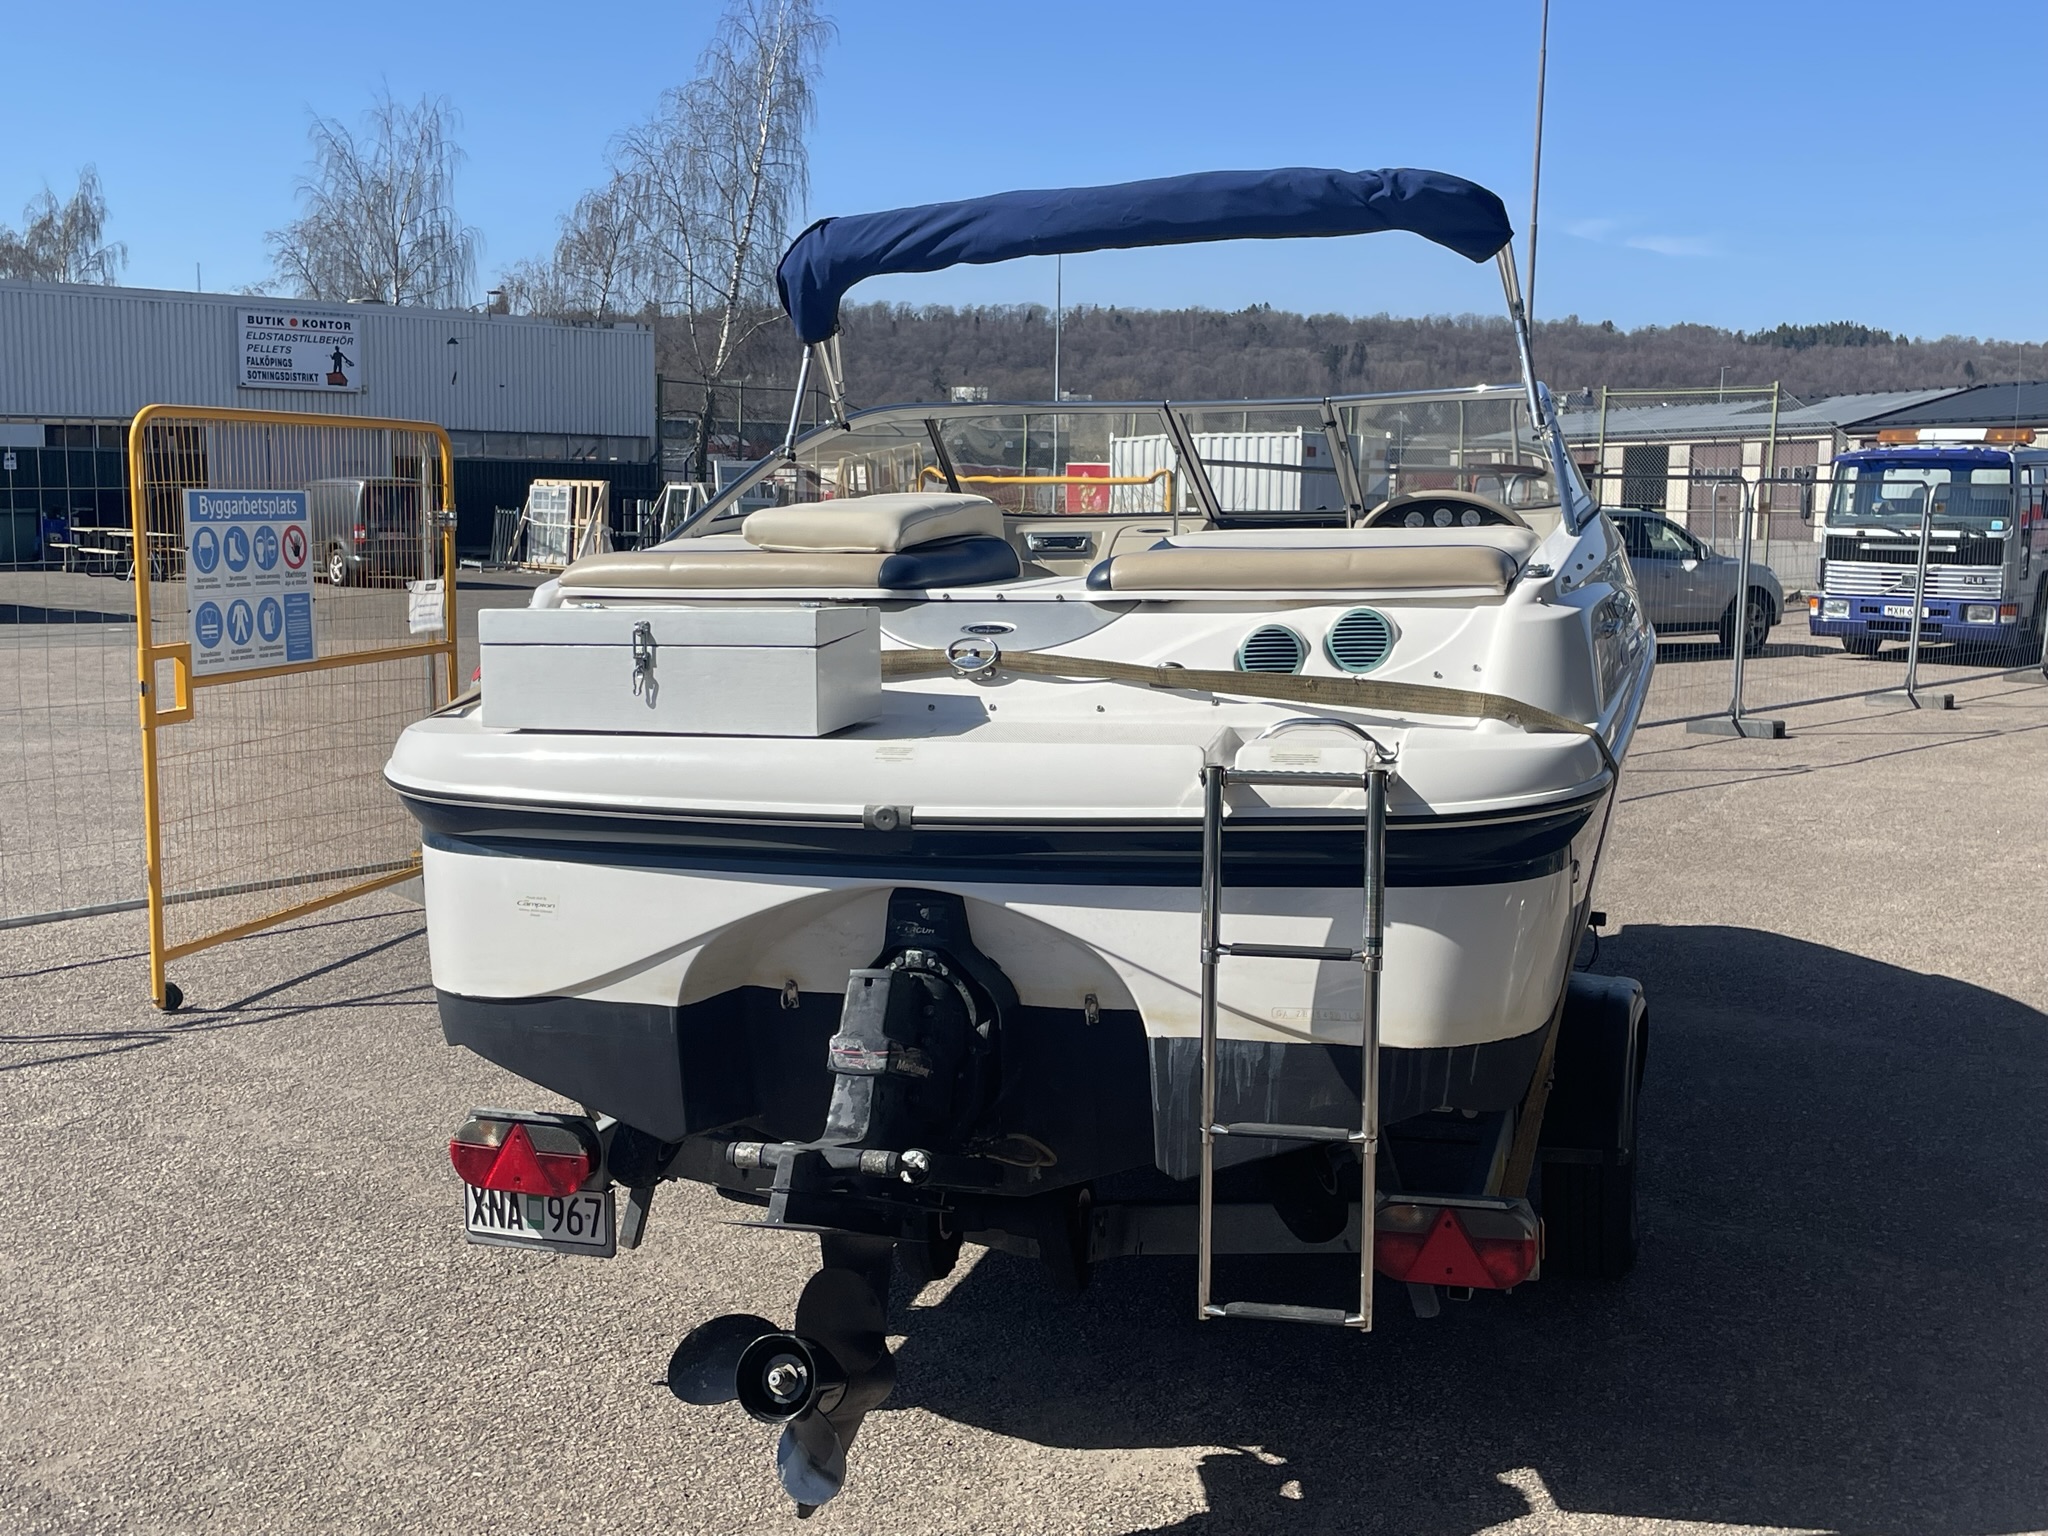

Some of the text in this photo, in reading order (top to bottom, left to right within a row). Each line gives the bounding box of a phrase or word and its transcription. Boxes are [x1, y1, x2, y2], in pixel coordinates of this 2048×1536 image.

[247, 315, 352, 331] BUTIK KONTOR
[246, 331, 354, 346] ELDSTADSTILLBEHÖR
[246, 344, 293, 355] PELLETS
[246, 355, 293, 368] FALKÖPINGS
[247, 370, 319, 383] SOTNINGSDISTRIKT
[199, 495, 298, 519] Byggarbetsplats
[1887, 606, 1905, 616] MXH
[470, 1186, 601, 1238] XNA 967
